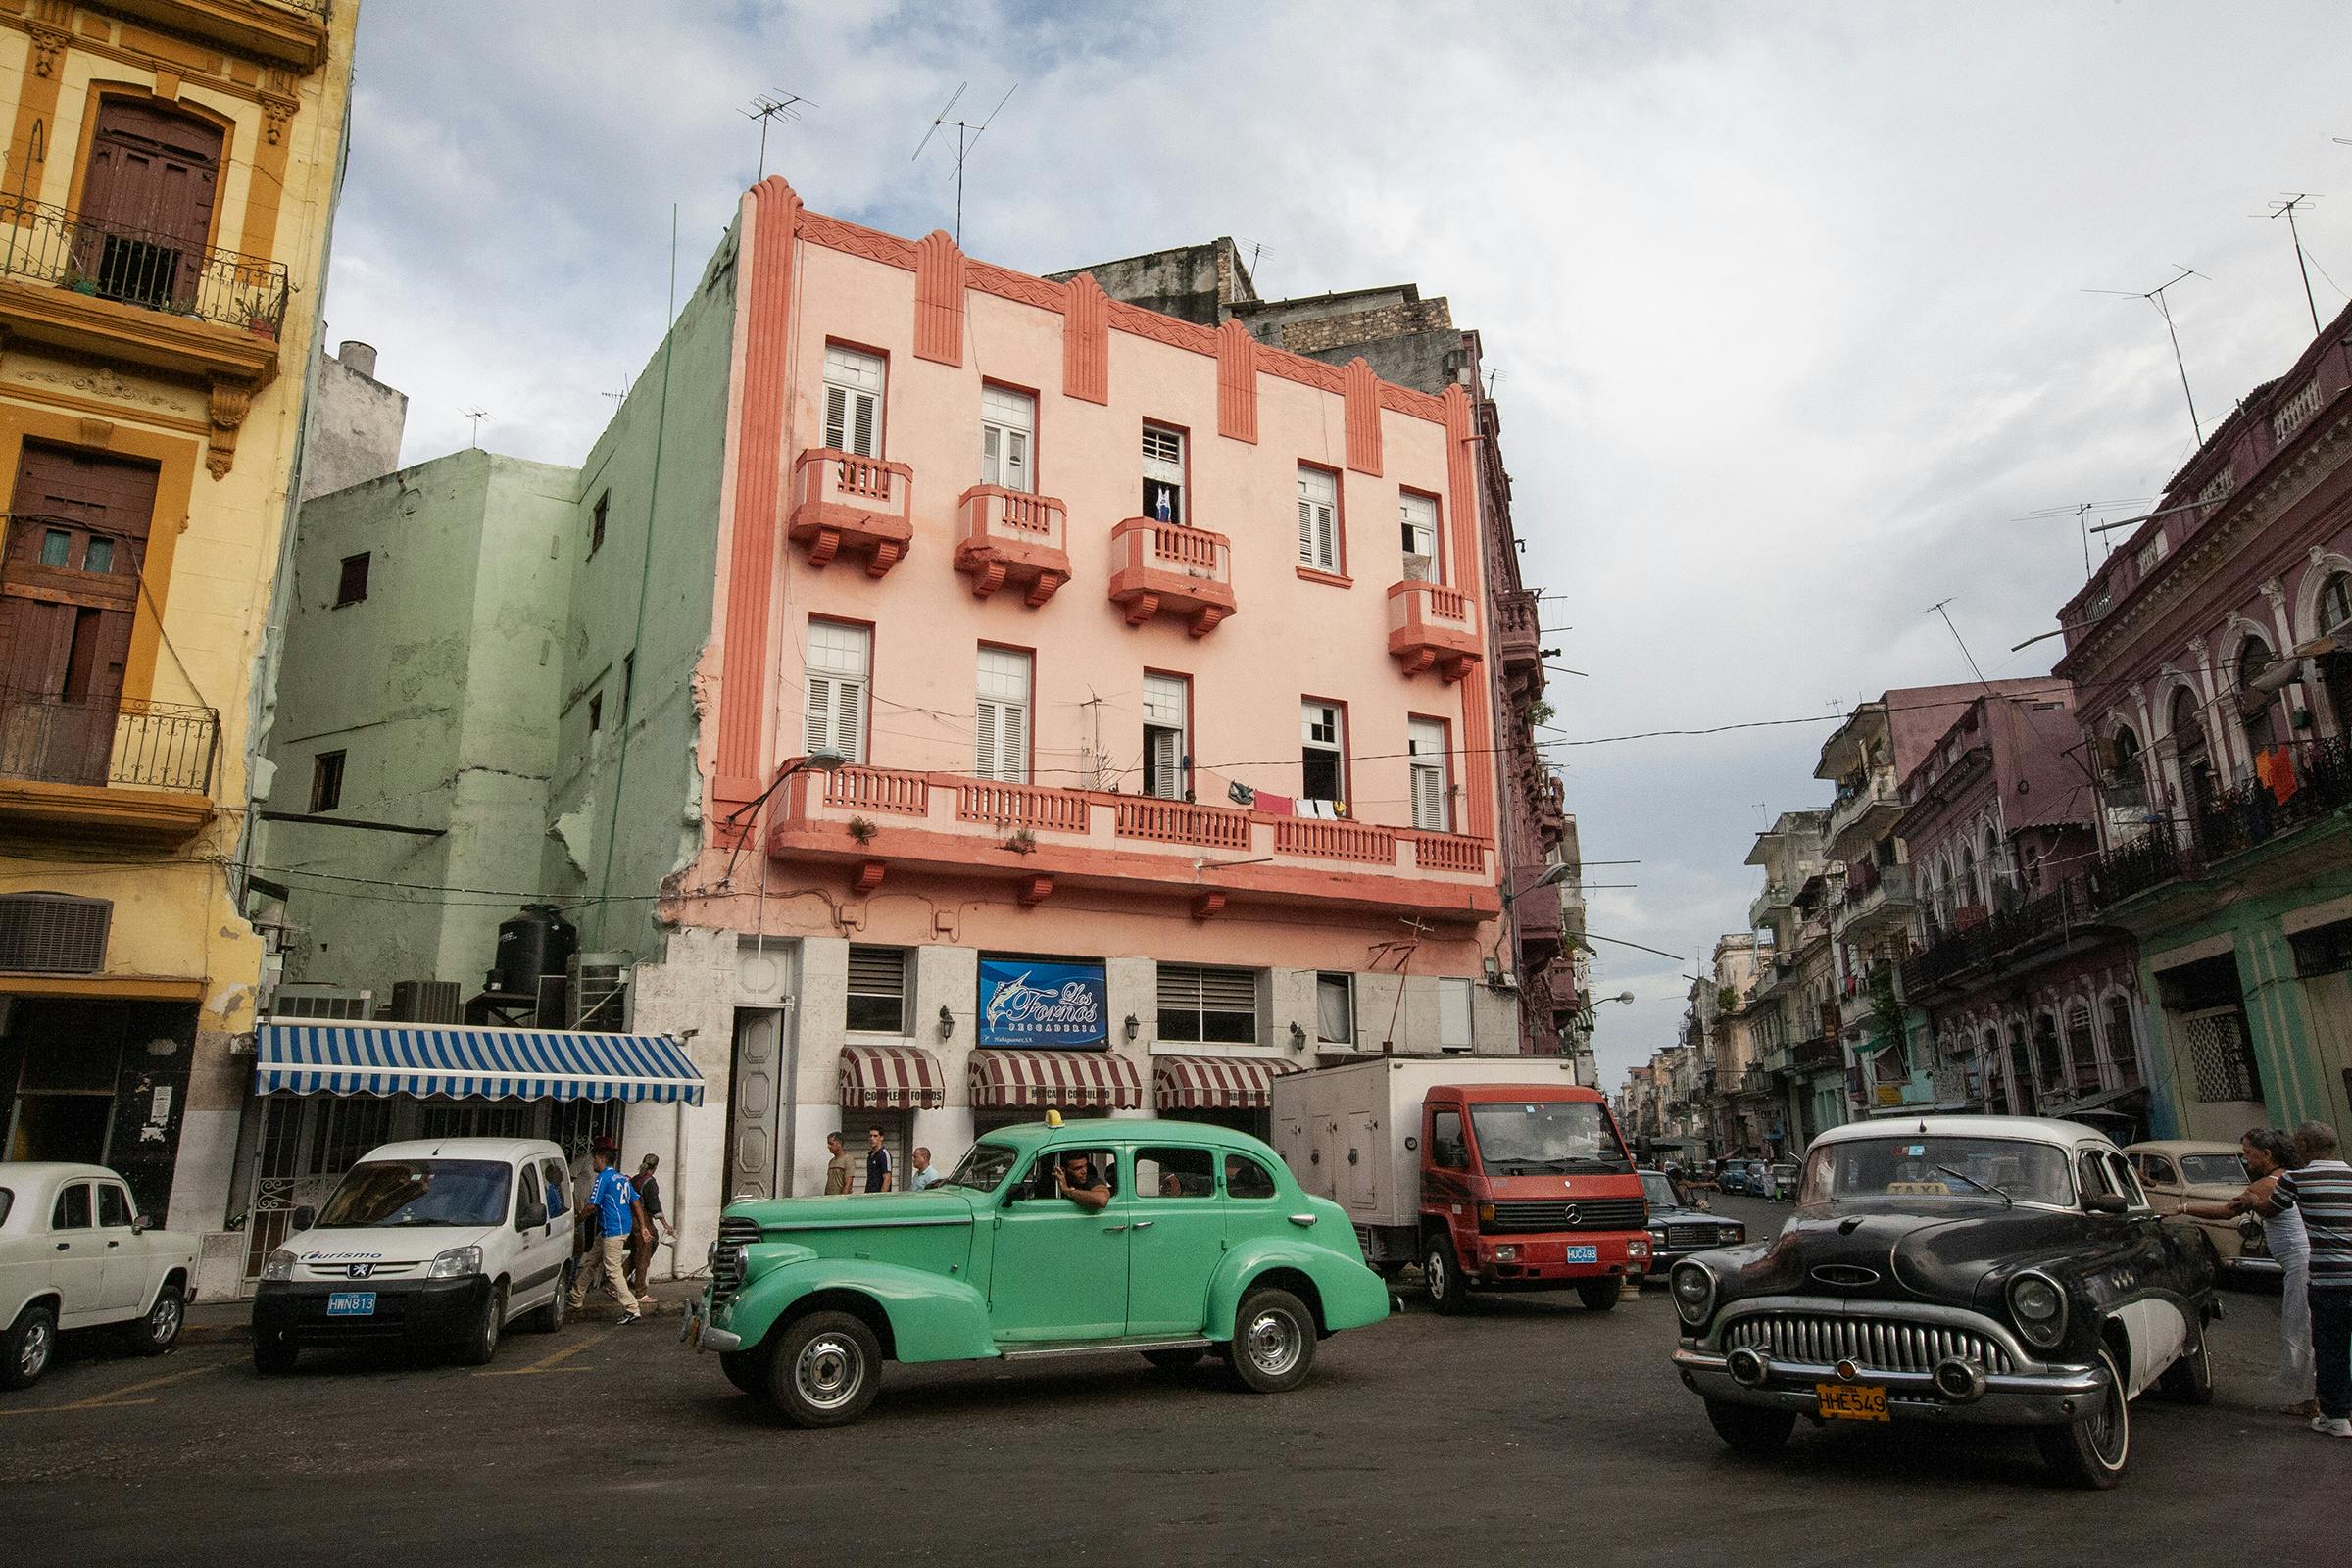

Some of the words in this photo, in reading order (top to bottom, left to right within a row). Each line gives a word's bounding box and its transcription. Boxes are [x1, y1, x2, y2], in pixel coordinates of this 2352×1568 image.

[1059, 982, 1092, 1005] Los
[1006, 986, 1098, 1022] Fornos
[1008, 1023, 1096, 1033] PESCADERIA
[910, 1090, 942, 1101] FORNOS
[1890, 1185, 1941, 1195] TAXI
[1568, 1250, 1595, 1259] HUC493
[329, 1298, 374, 1310] HWN813
[1817, 1392, 1886, 1412] HHE549
